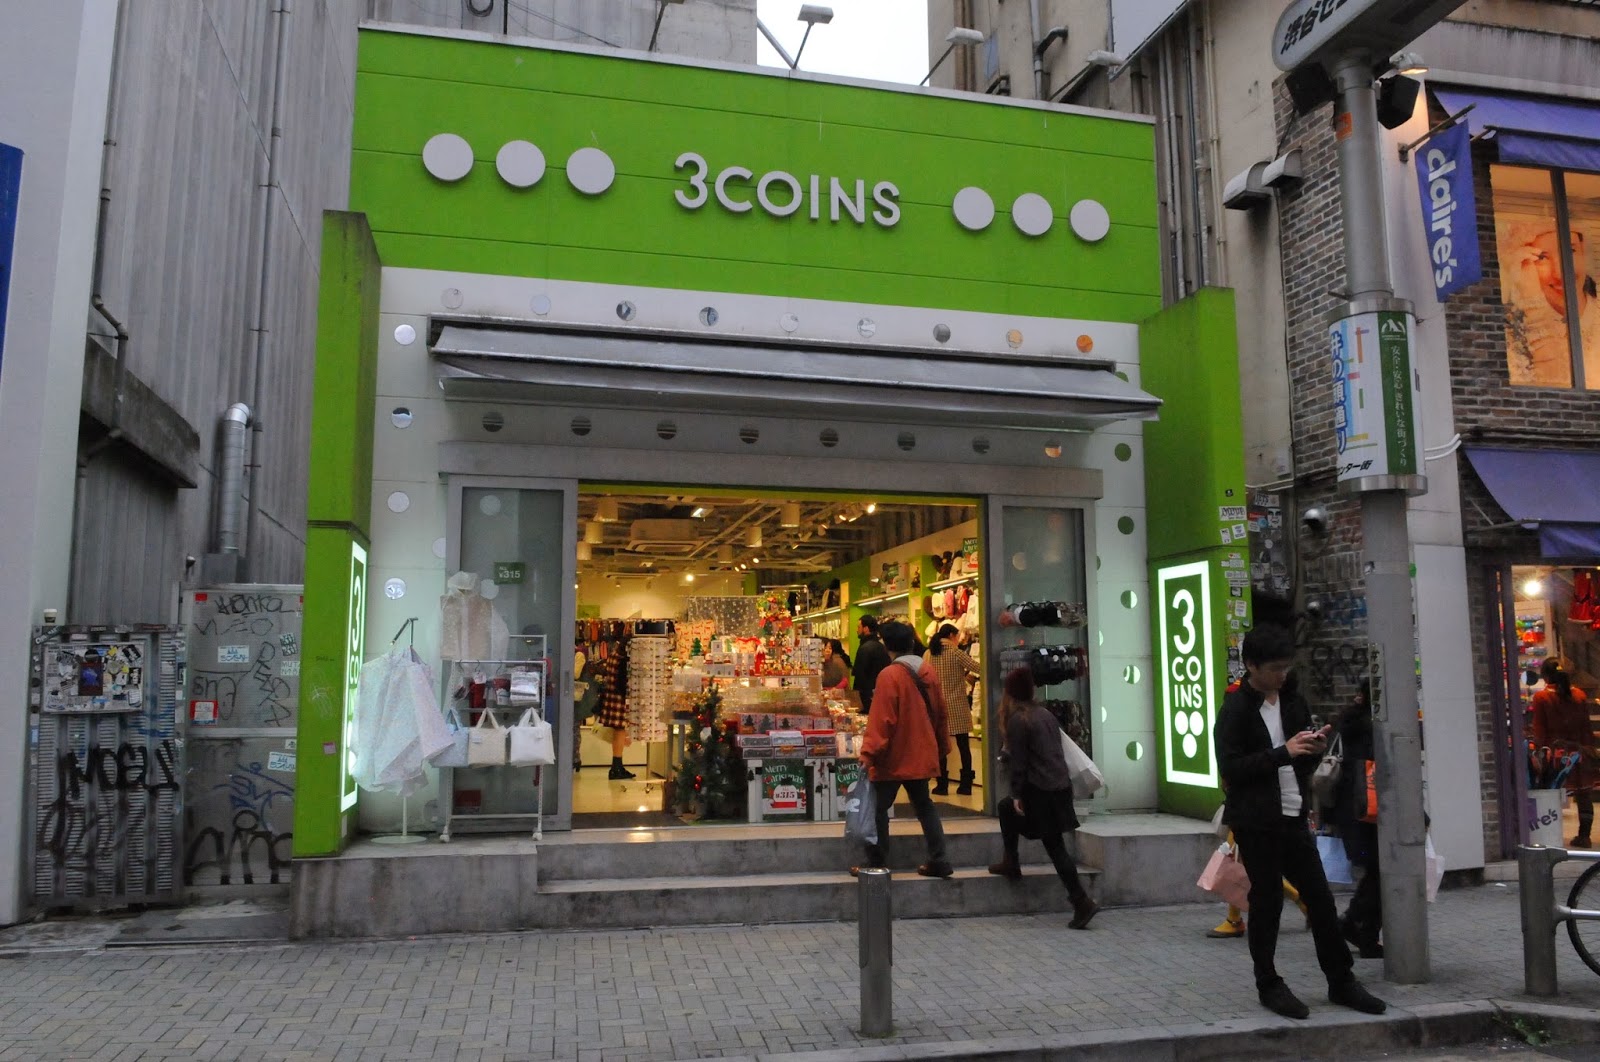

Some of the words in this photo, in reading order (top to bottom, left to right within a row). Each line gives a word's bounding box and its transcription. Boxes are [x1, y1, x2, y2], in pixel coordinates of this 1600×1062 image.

[673, 152, 901, 228] 3COINS
[1425, 147, 1460, 289] claire's
[1172, 588, 1196, 655] 3
[765, 764, 788, 773] Merry
